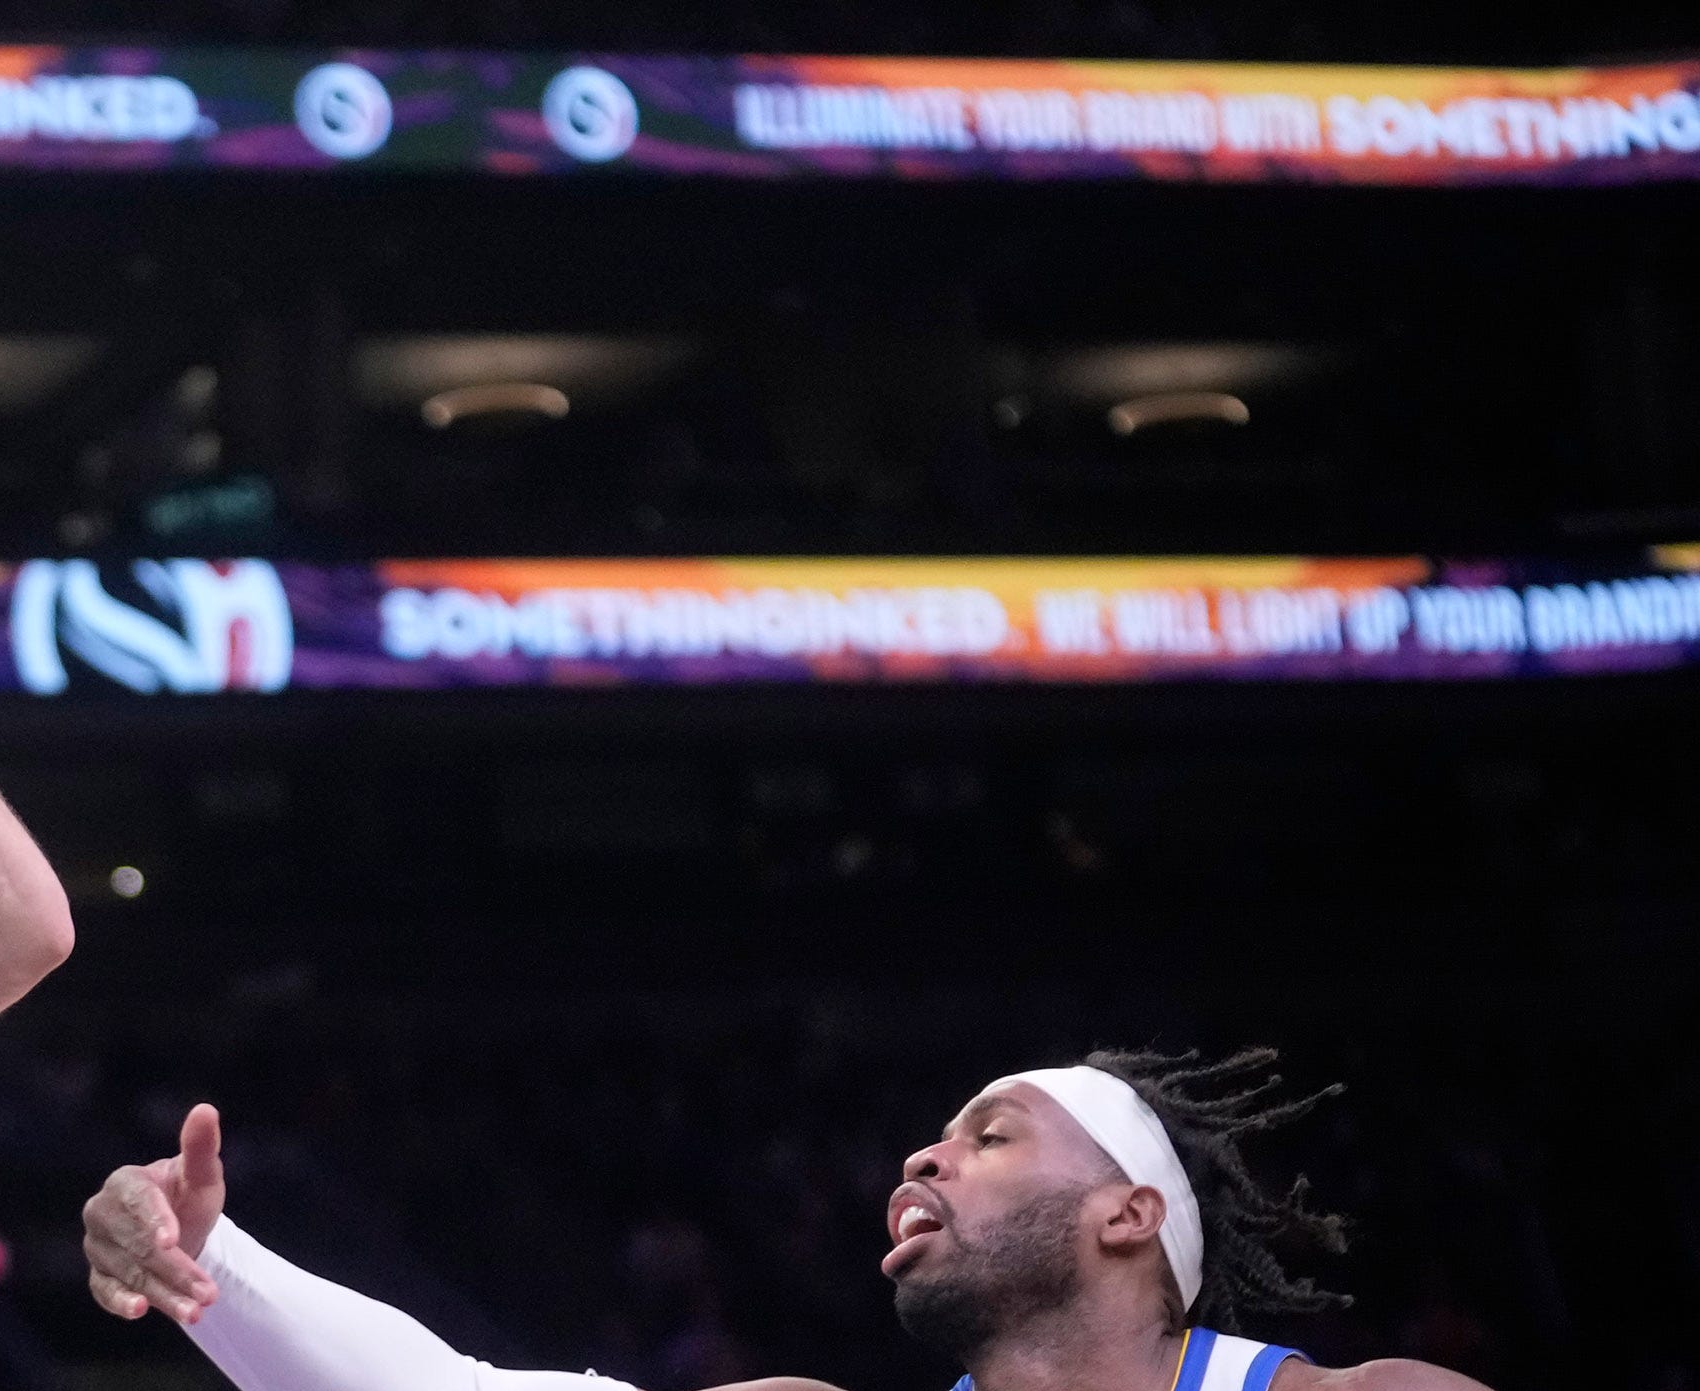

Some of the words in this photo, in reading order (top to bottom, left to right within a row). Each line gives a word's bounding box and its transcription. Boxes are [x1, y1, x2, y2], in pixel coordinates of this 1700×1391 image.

[1111, 587, 1219, 655] WILL
[1219, 587, 1342, 655] LIGHT
[1349, 585, 1409, 655] UP
[1410, 585, 1526, 656] YOUR
